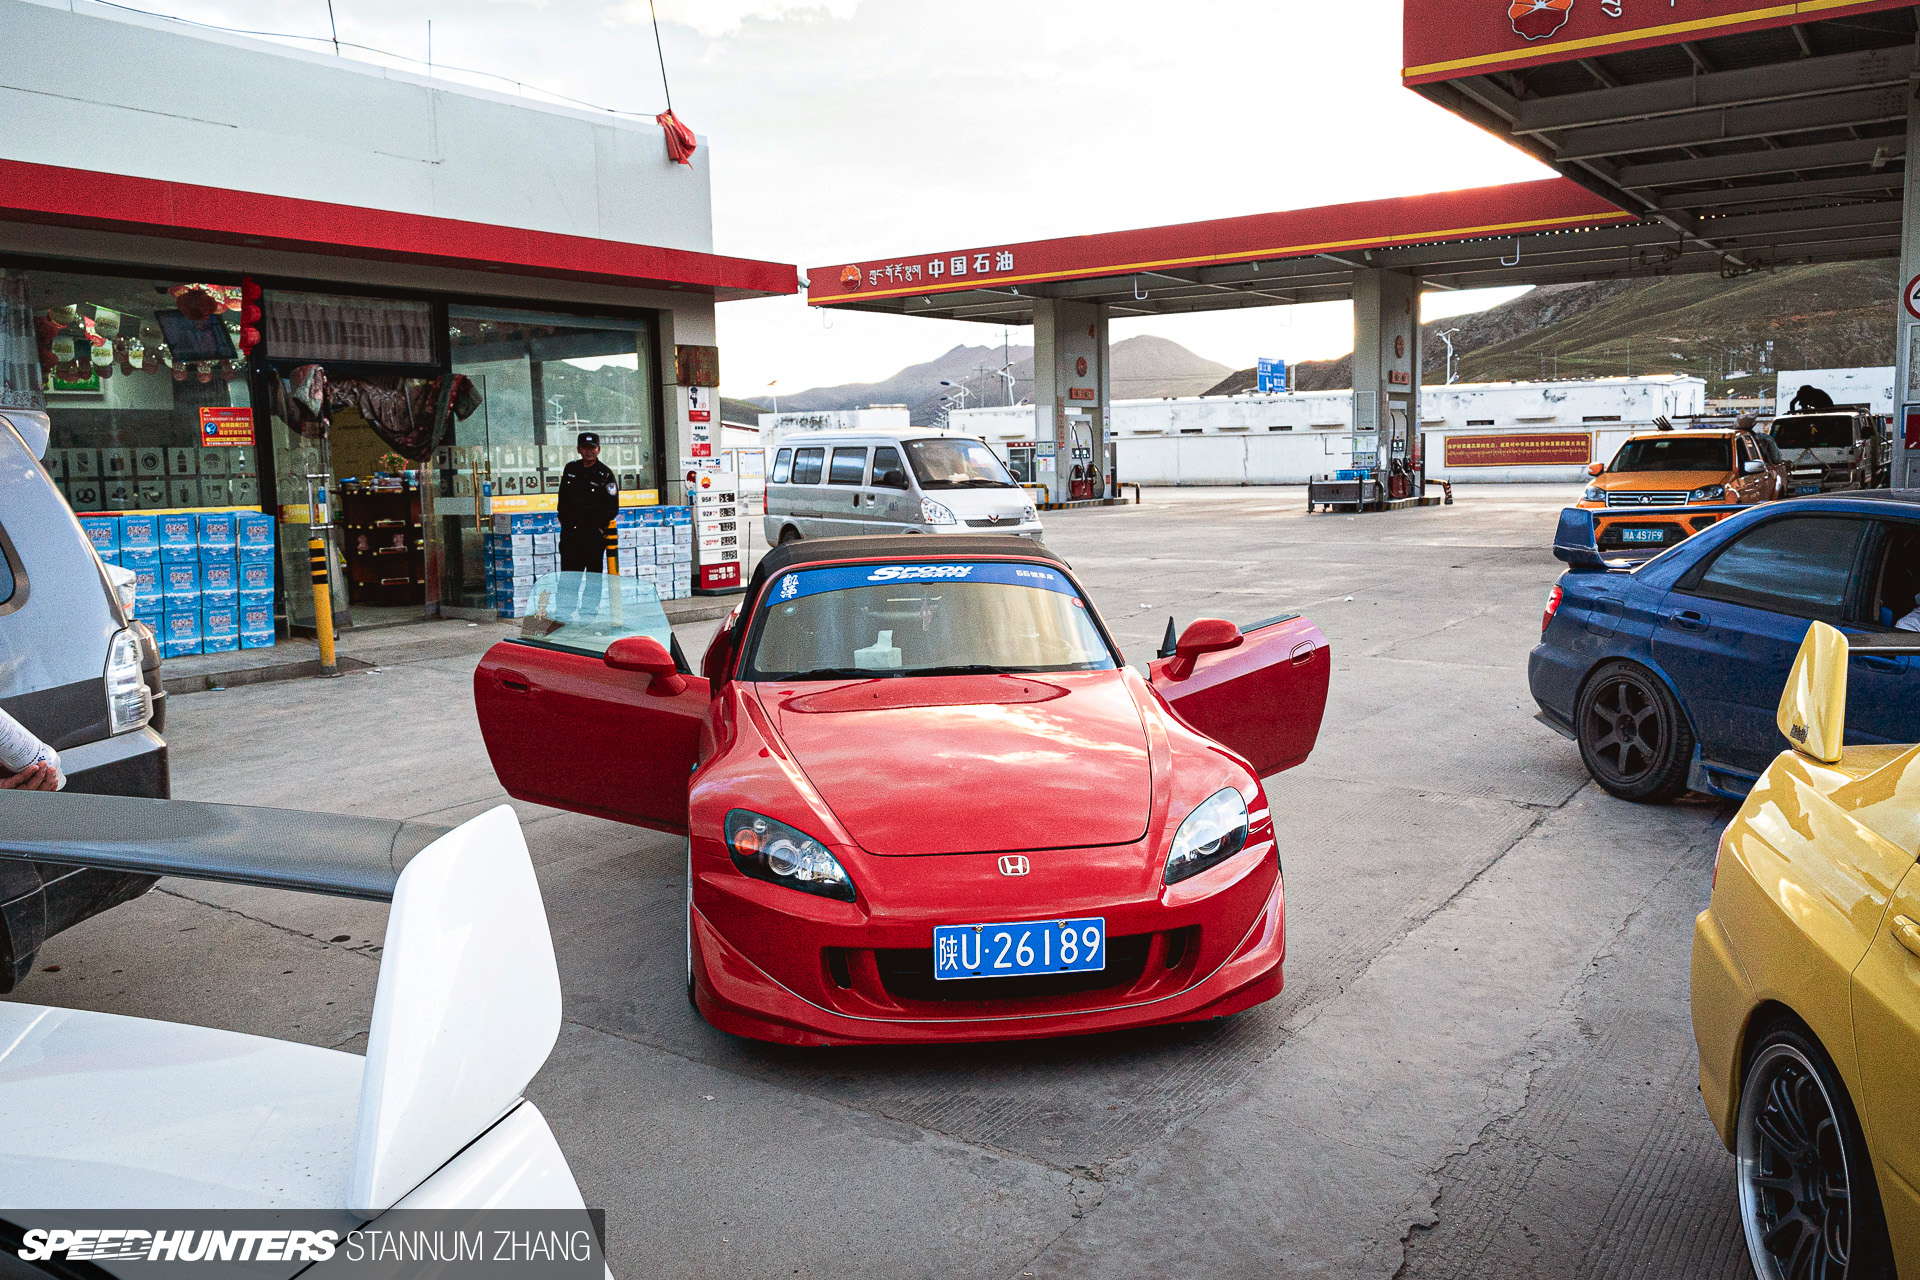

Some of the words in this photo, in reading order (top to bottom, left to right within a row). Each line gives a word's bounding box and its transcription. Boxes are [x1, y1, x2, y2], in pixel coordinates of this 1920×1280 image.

[928, 250, 1014, 279] 中国石油
[867, 566, 974, 581] SPOON
